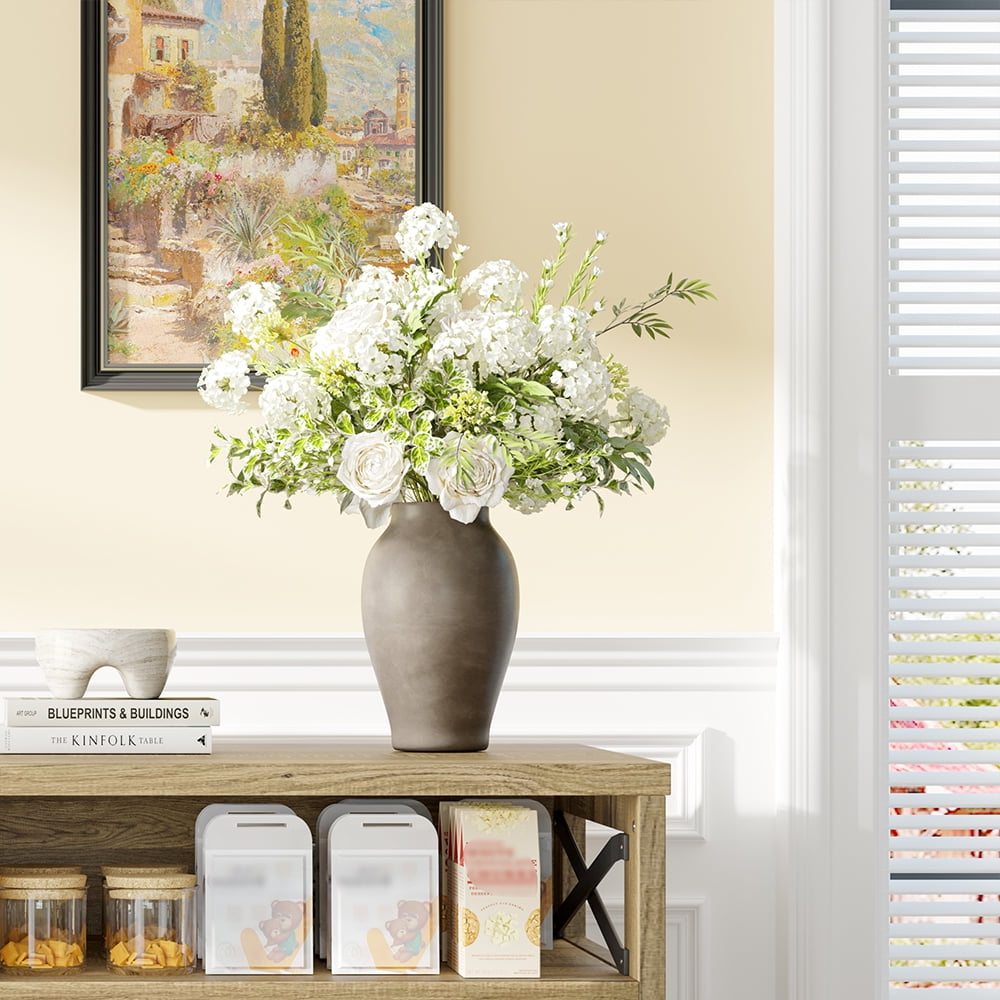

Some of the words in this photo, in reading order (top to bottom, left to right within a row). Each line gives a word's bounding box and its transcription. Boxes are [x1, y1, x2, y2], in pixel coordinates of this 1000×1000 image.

[48, 707, 116, 719] BLUEPRINTS
[119, 707, 127, 719] &
[130, 707, 189, 719] BUILDINGS
[51, 736, 67, 744] THE
[72, 735, 136, 746] KINFOLK
[139, 737, 163, 745] TABLE
